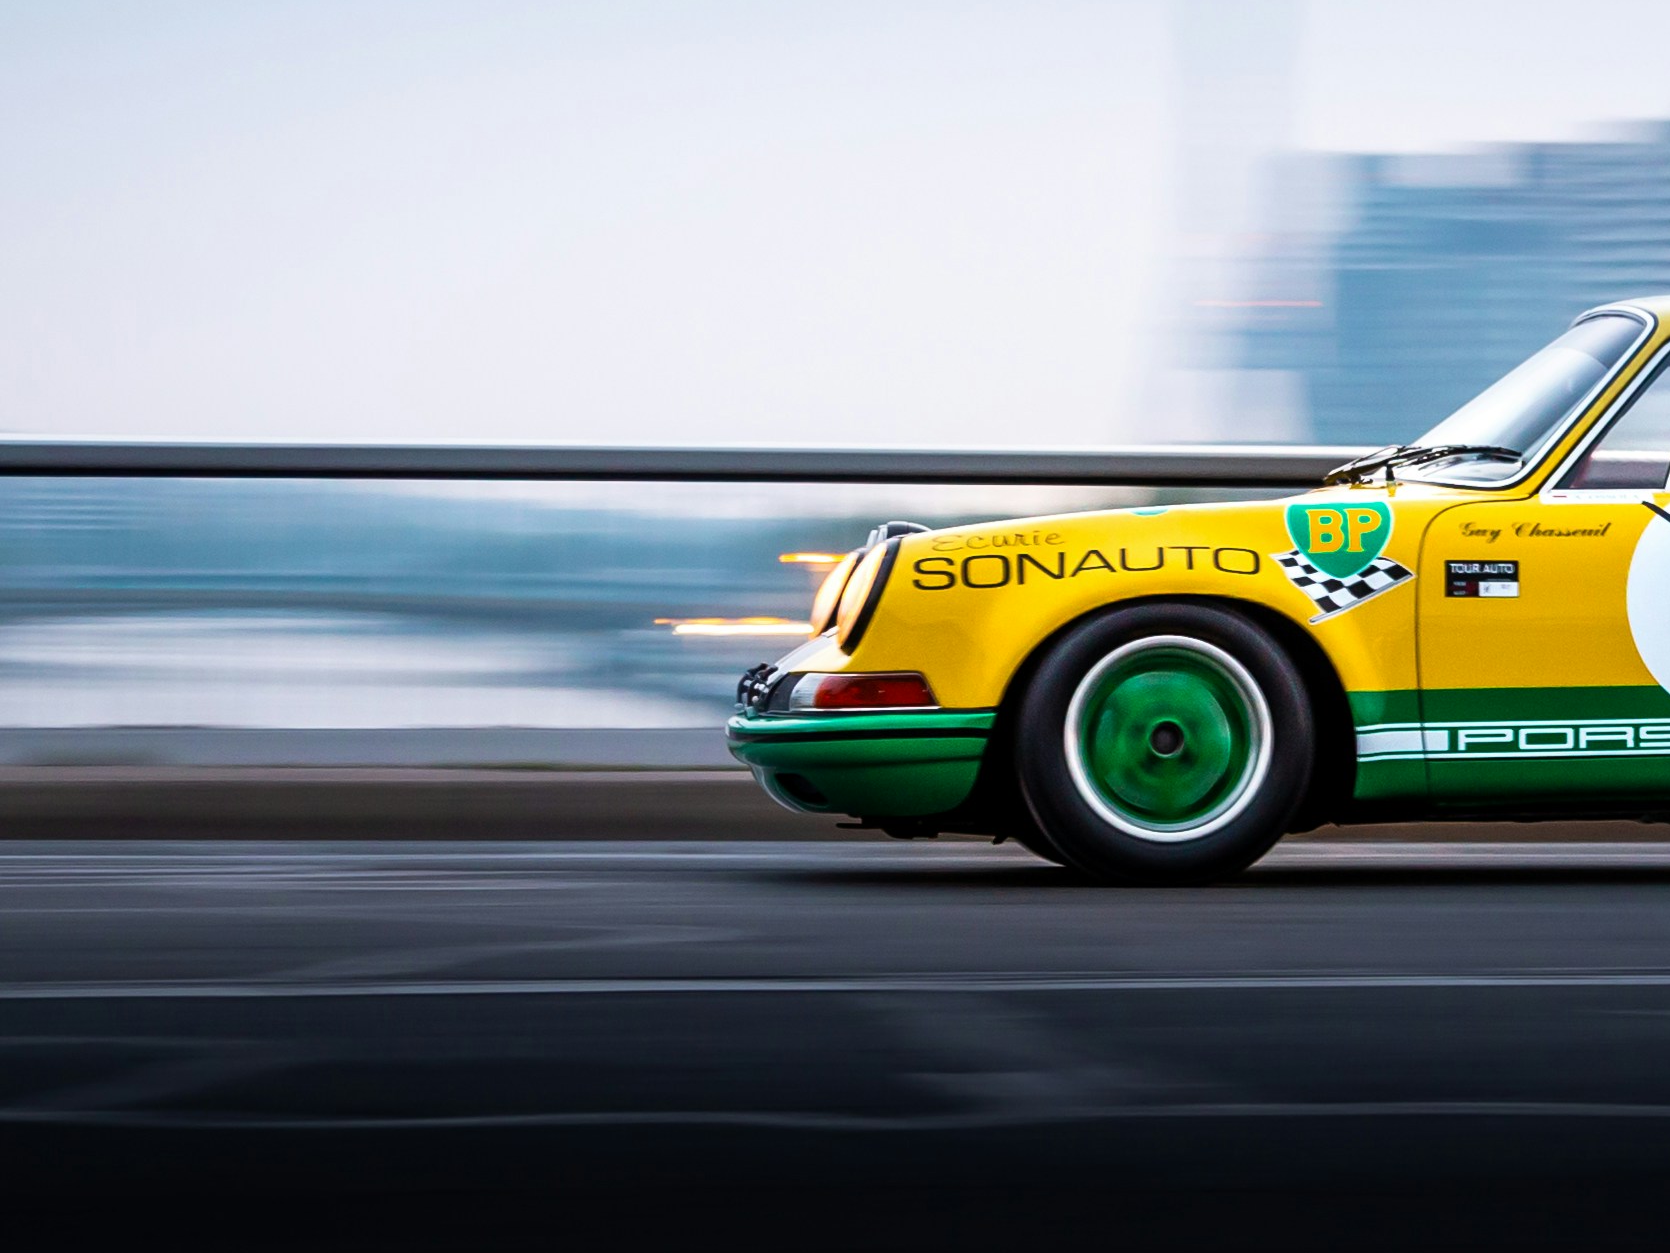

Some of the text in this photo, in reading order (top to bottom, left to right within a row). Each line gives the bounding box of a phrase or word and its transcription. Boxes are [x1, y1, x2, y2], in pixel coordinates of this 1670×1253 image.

[931, 530, 1065, 552] Ecurie
[1305, 508, 1382, 553] BP
[912, 546, 1261, 591] SONAUTO
[1449, 563, 1516, 574] TOUR AUTO
